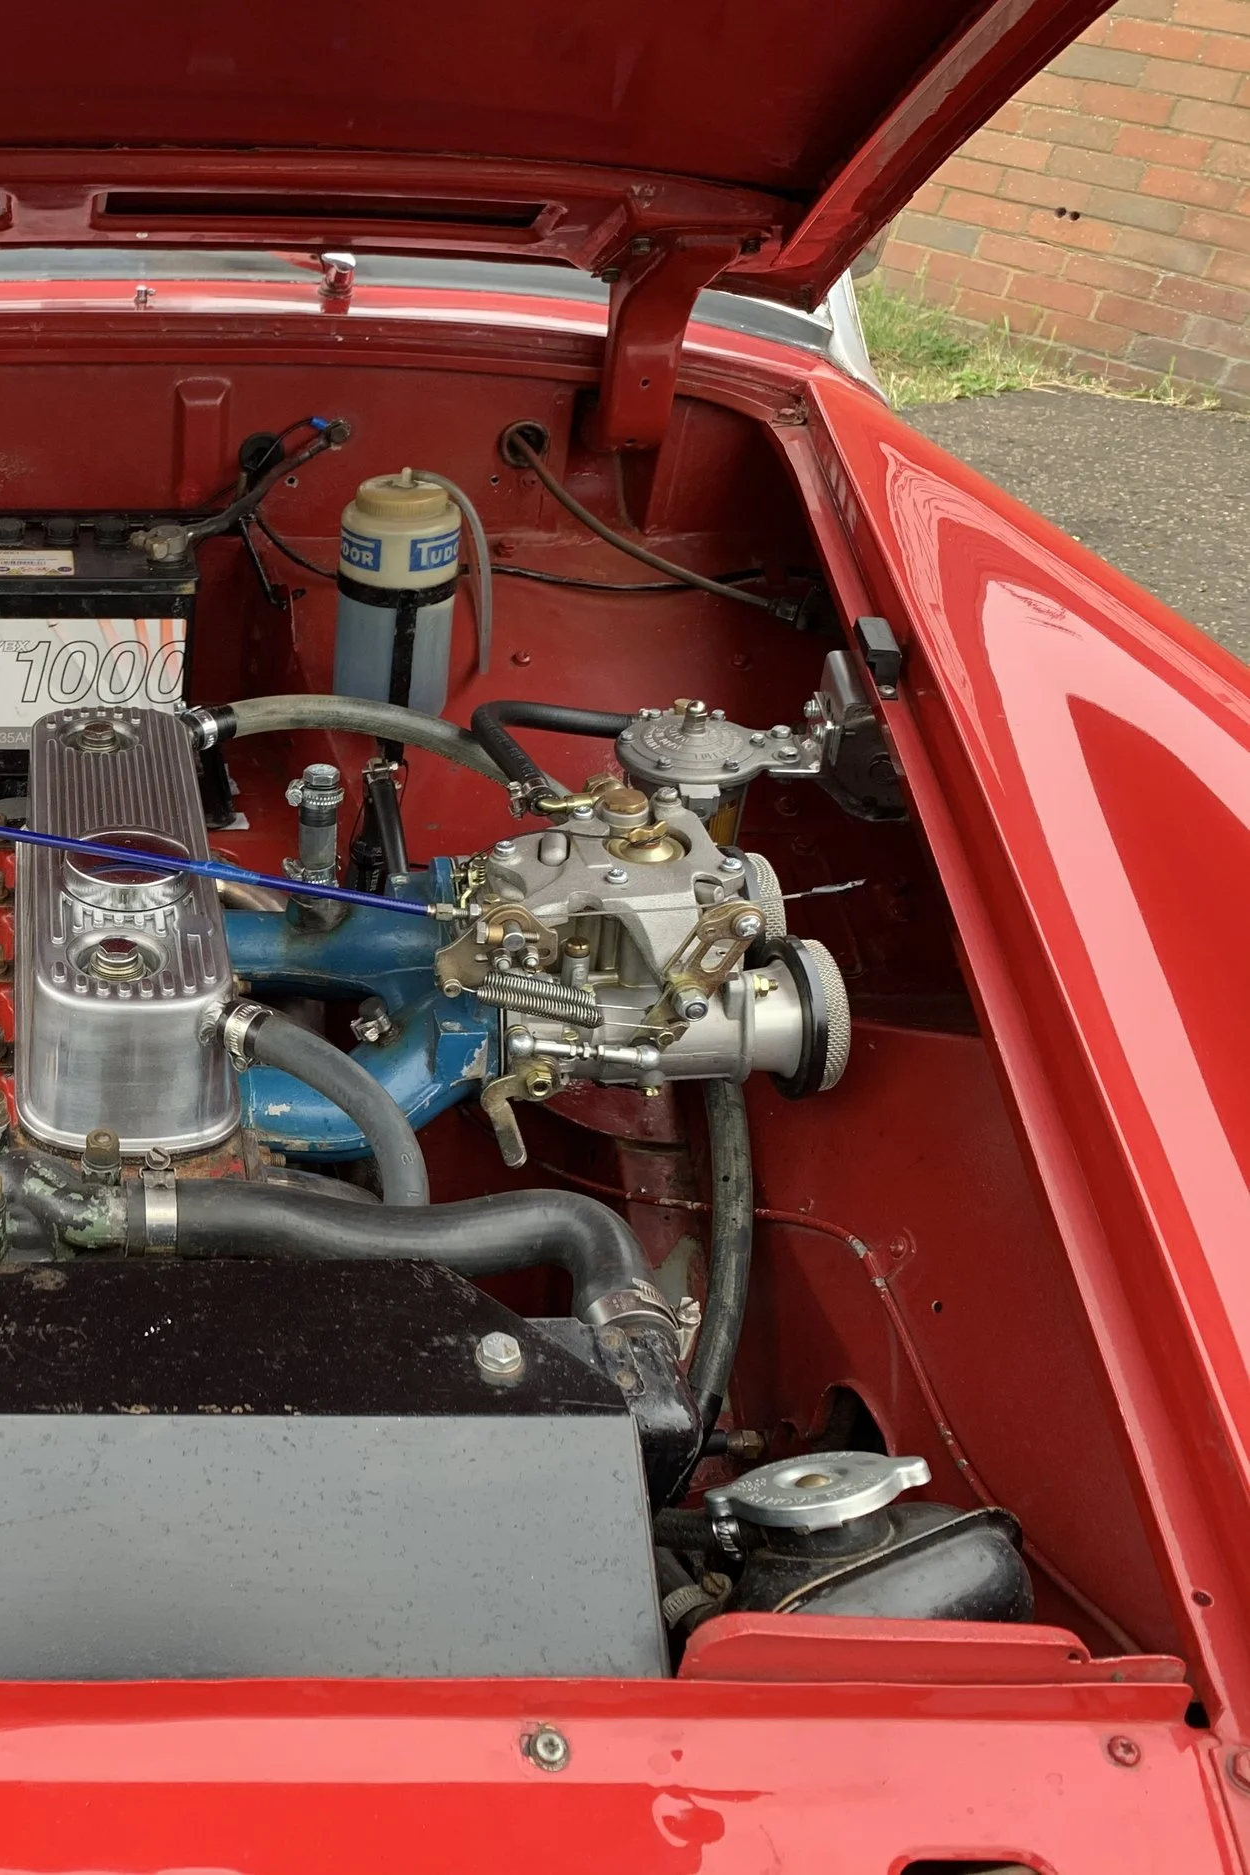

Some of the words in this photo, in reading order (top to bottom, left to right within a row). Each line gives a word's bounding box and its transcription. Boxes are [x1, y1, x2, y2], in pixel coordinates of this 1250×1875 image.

[341, 530, 375, 566] DOR
[416, 530, 460, 566] TUDO
[16, 640, 186, 704] 1000
